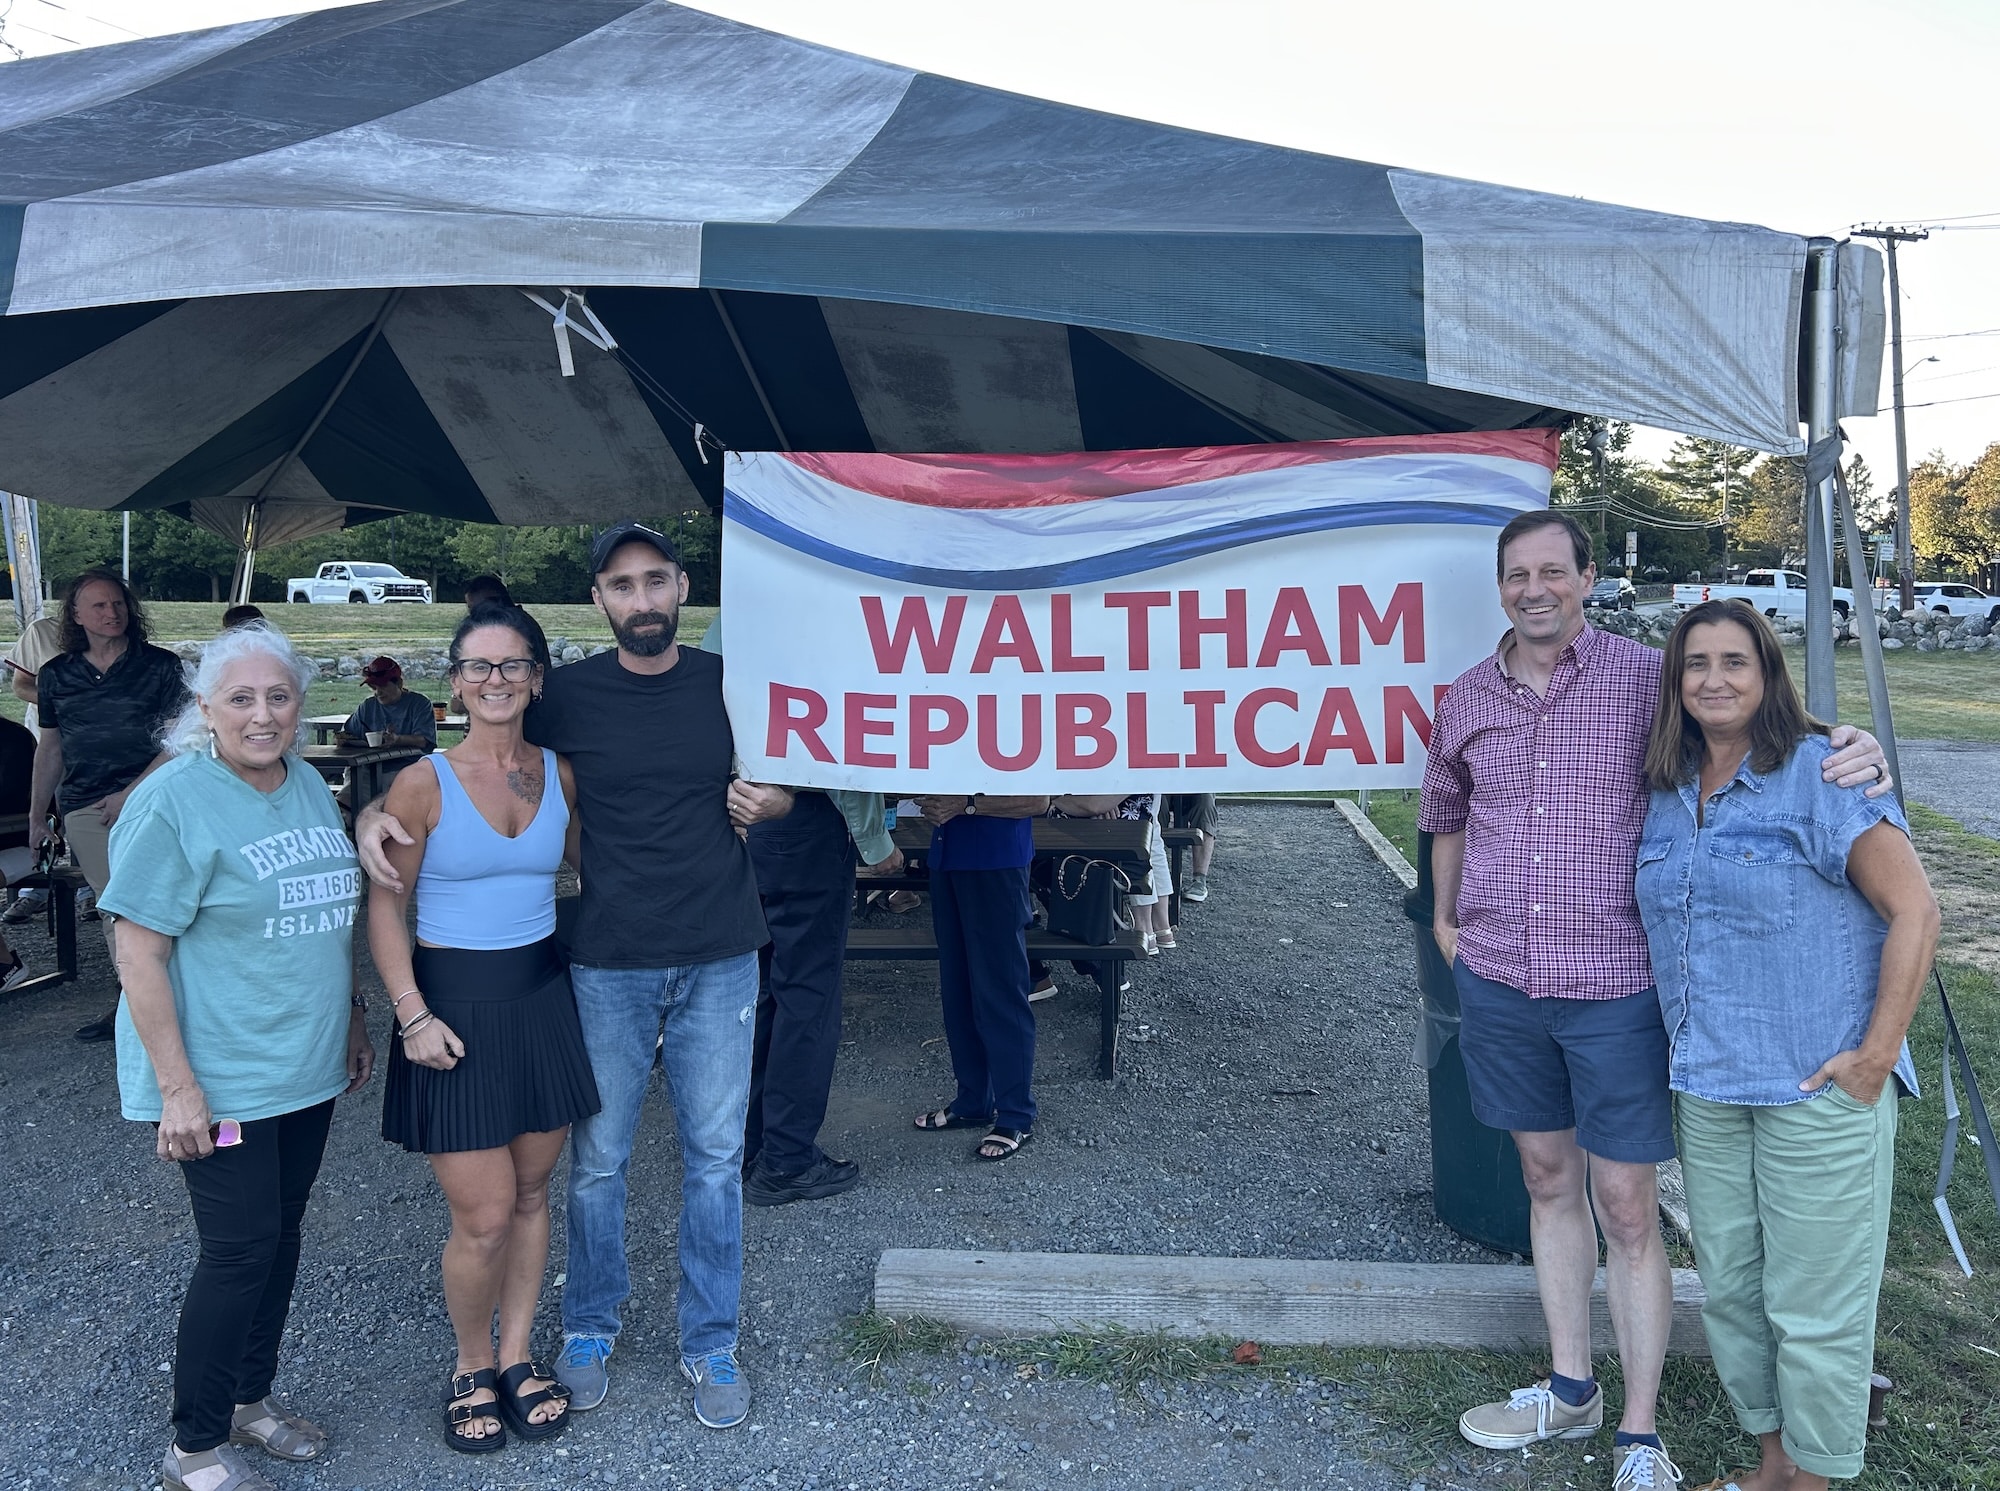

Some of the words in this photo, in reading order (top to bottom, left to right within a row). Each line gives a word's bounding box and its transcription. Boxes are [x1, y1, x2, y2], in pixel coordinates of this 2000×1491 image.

[861, 583, 1425, 674] WALTHAM
[766, 683, 1451, 771] REPUBLICAN
[240, 826, 359, 881] BERMUD
[283, 872, 361, 904] EST.1609
[264, 905, 359, 938] ISLAND
